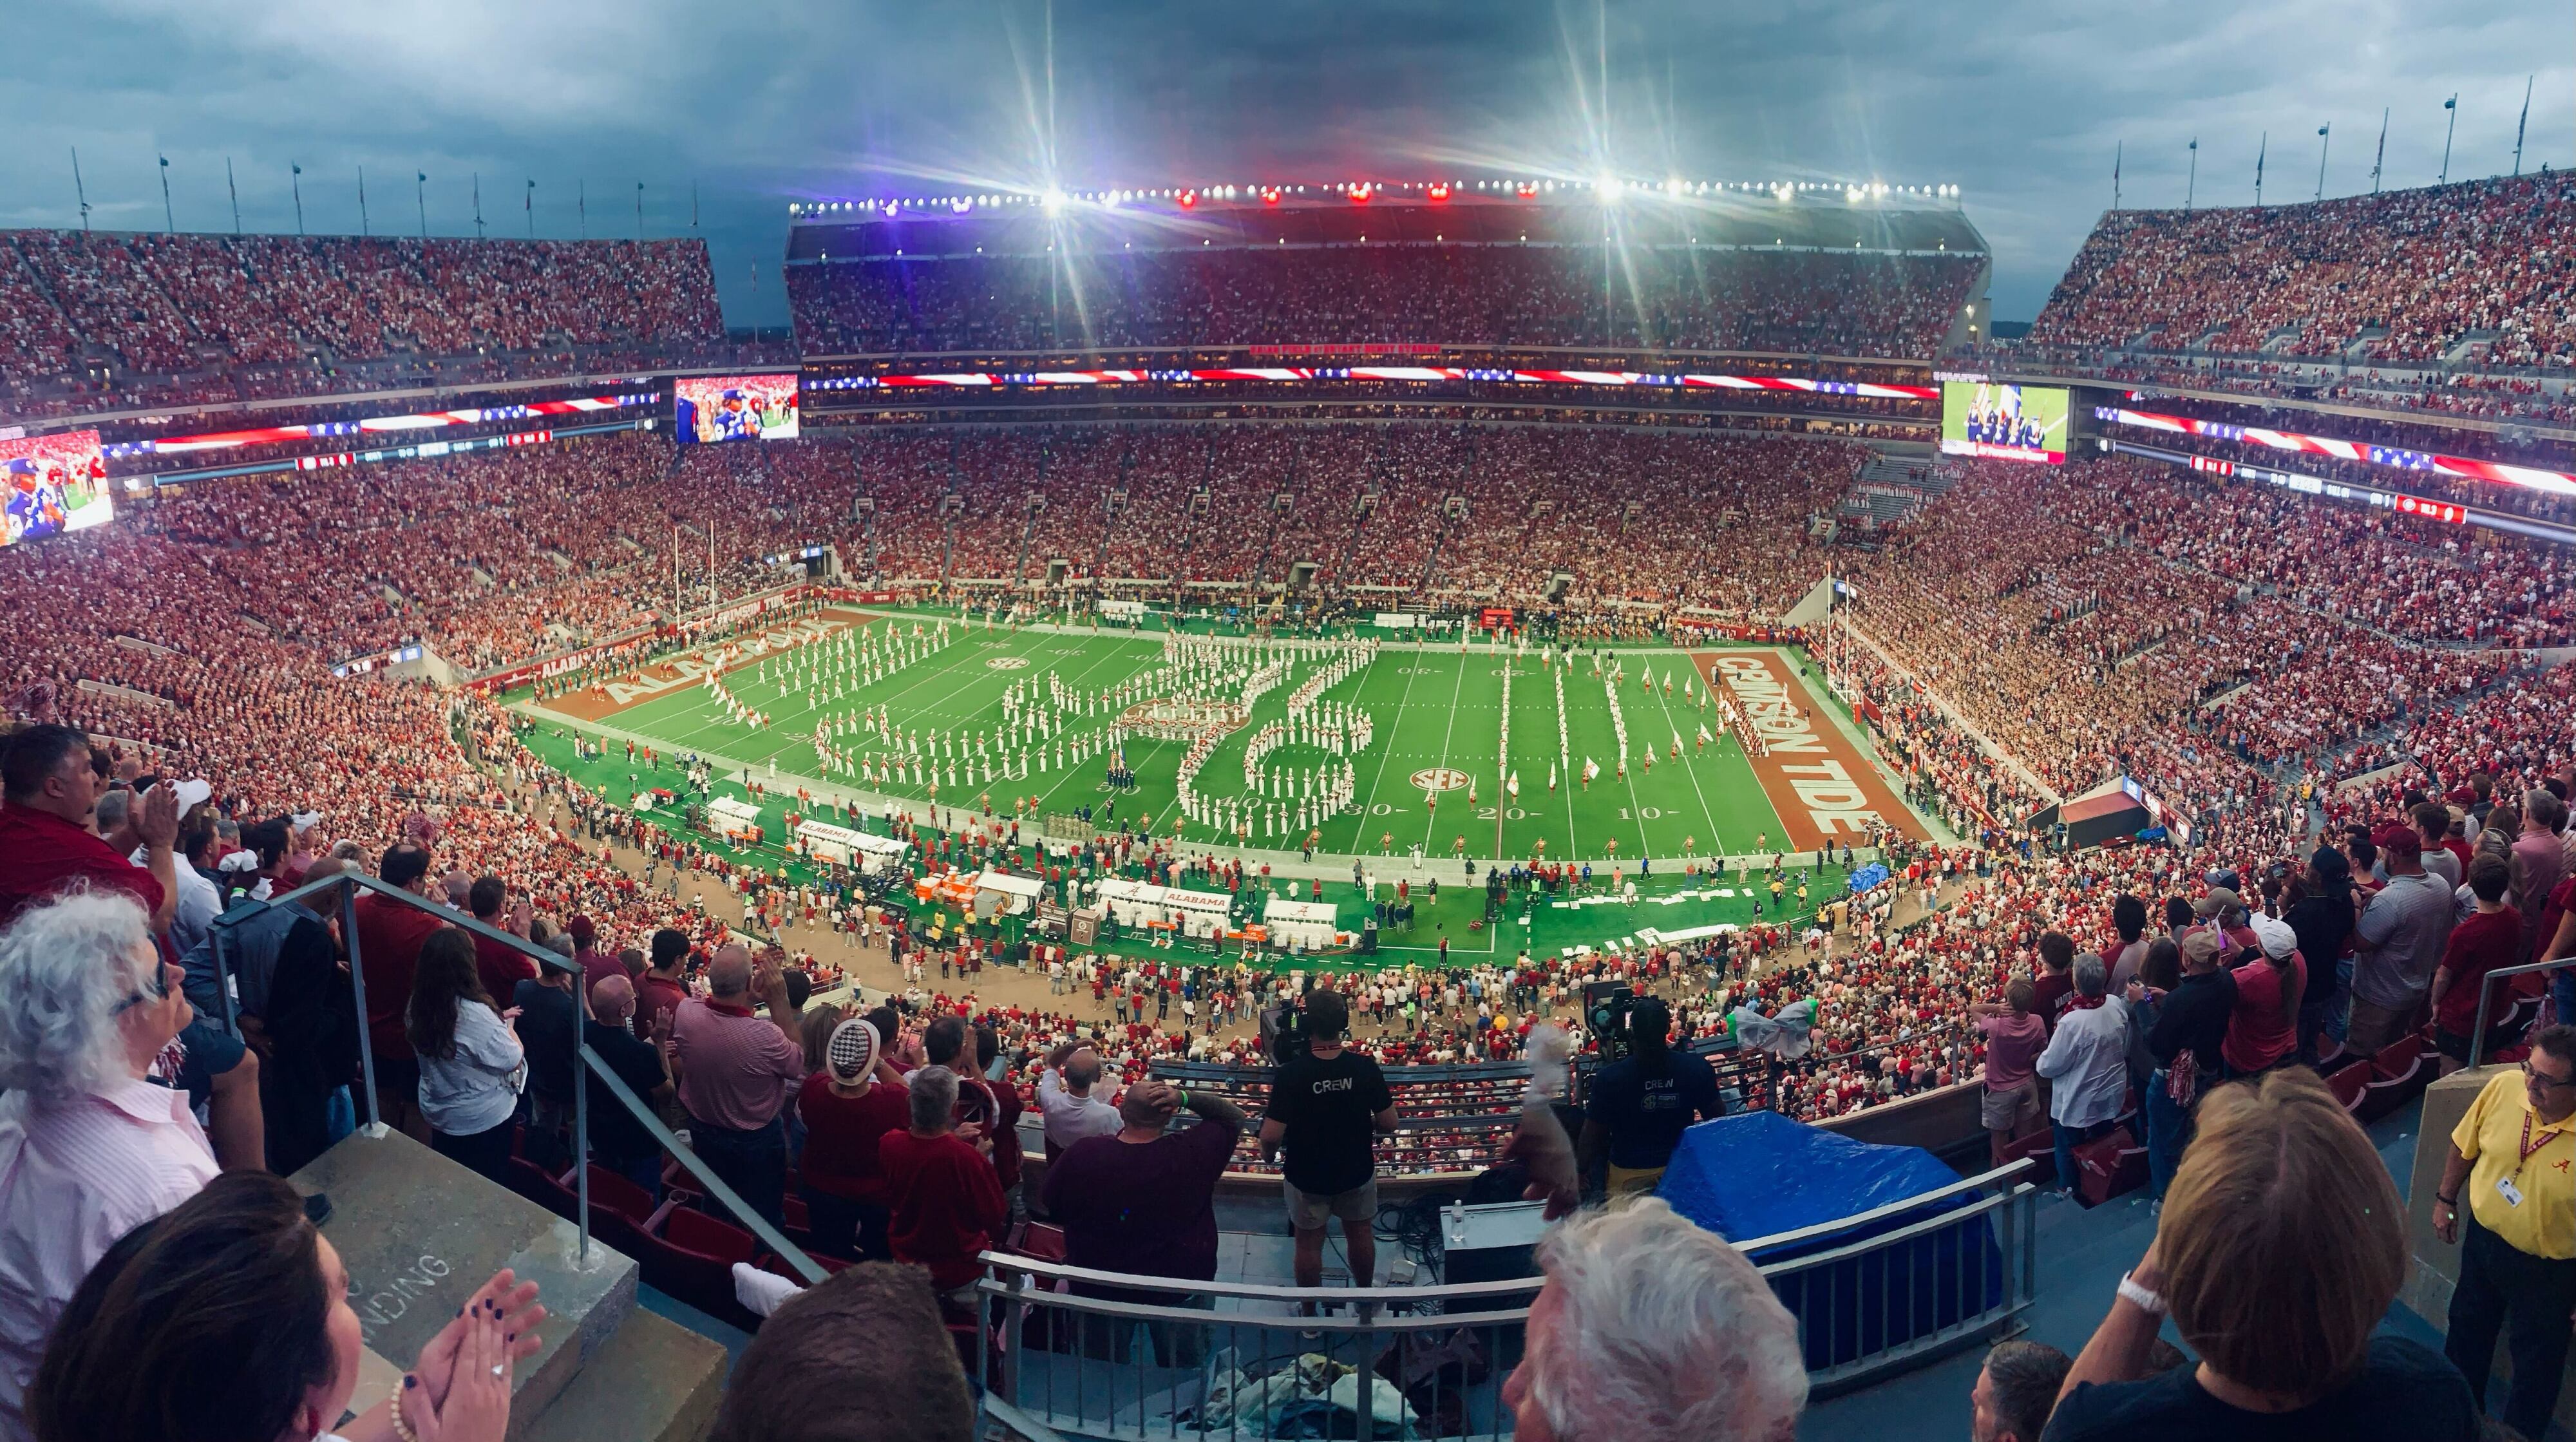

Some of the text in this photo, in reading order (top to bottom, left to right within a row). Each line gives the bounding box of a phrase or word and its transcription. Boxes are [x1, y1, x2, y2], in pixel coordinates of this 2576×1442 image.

[1415, 770, 1469, 790] SEC
[1780, 759, 1888, 834] TIDE
[1343, 804, 1392, 816] 30
[1477, 807, 1526, 820] 20
[1617, 807, 1662, 820] 10
[803, 824, 848, 839] ALABAMA
[1167, 893, 1227, 907] ALABAMA
[1312, 1077, 1352, 1094] CREW
[1645, 1078, 1674, 1090] CREW
[359, 1255, 450, 1345] NDING
